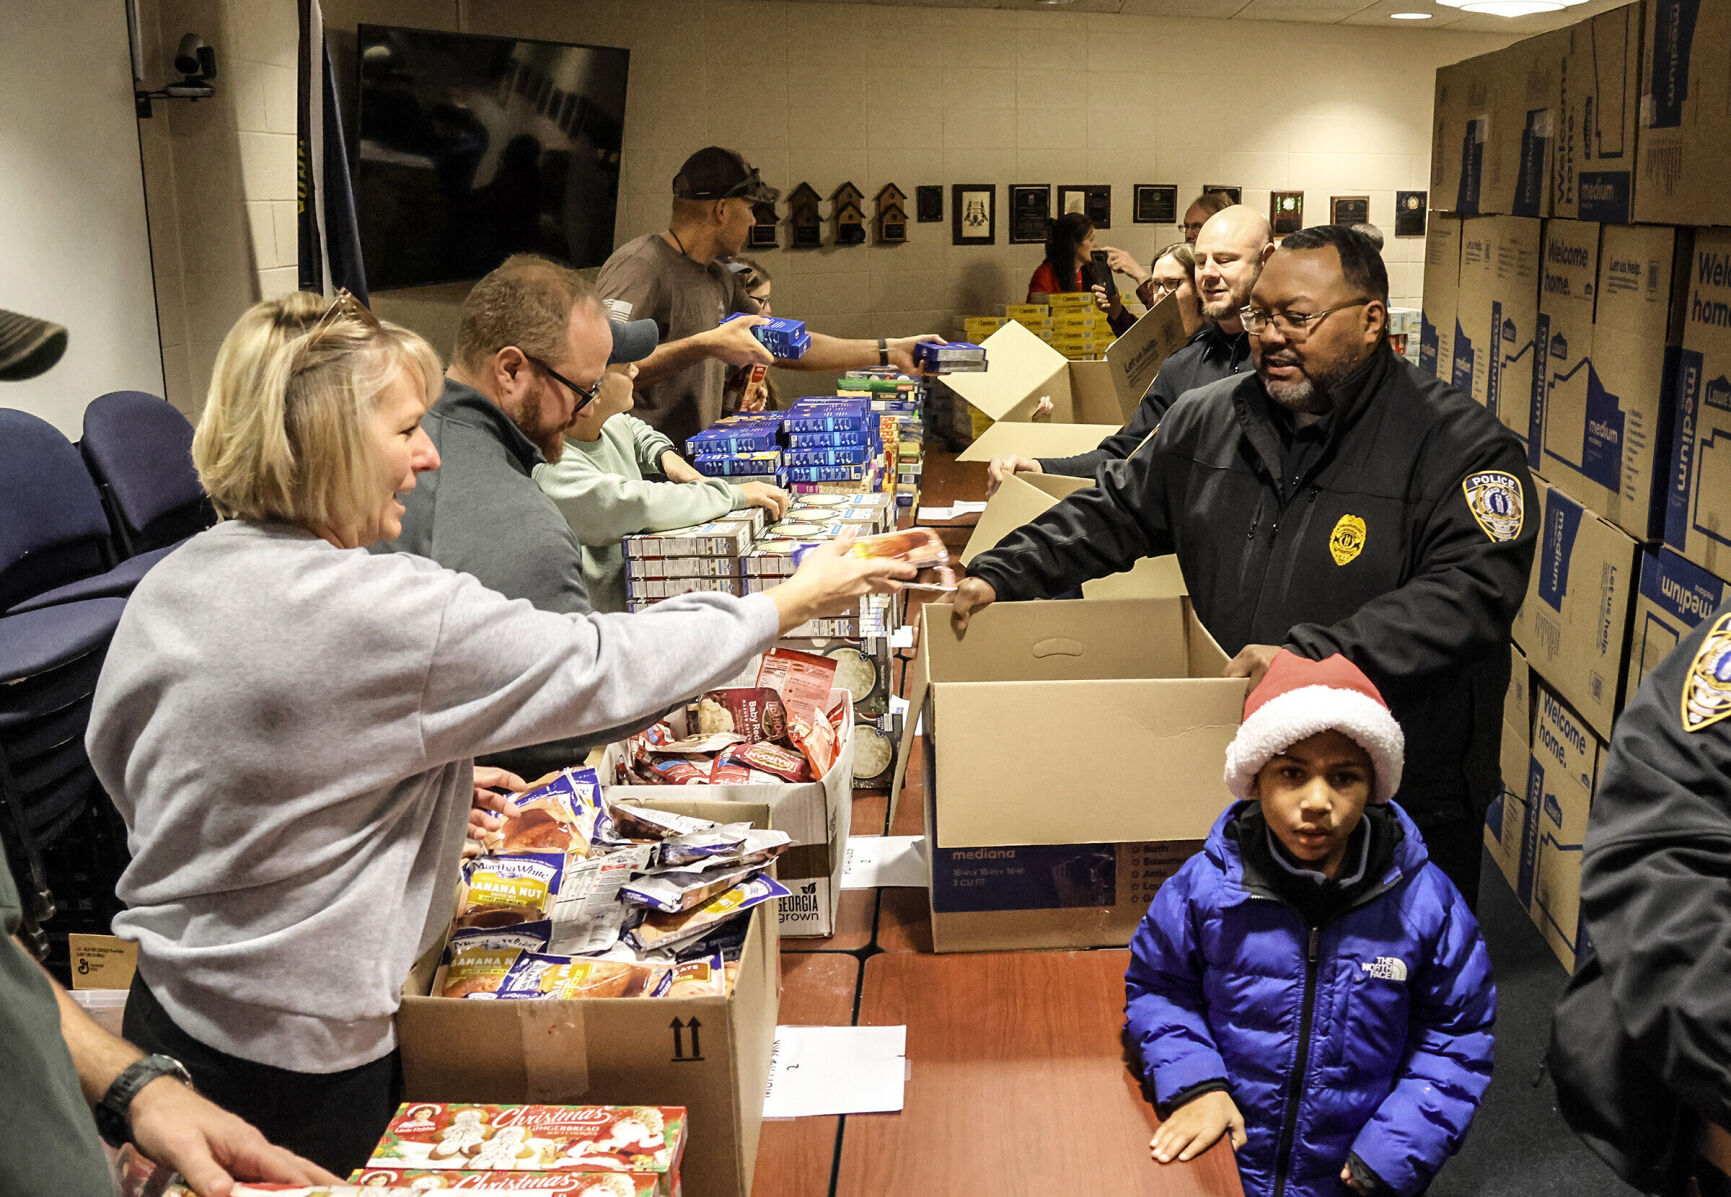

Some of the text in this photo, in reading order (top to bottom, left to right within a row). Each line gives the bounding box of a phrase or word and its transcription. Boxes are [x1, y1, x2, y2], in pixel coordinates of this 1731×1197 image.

[1549, 238, 1588, 268] Welcome
[1588, 420, 1618, 445] medium
[1677, 367, 1697, 492] medium
[1471, 474, 1515, 490] POLICE
[1552, 510, 1565, 592] medium
[1661, 575, 1713, 619] medium
[749, 701, 762, 741] Baby Red
[1544, 691, 1586, 755] Welcome
[1539, 716, 1567, 769] home.
[952, 848, 1016, 861] mediana
[472, 861, 516, 873] Martha
[517, 865, 550, 880] White
[519, 886, 543, 900] NUT
[779, 895, 819, 912] GEORGIA
[779, 913, 819, 923] grown
[1361, 963, 1393, 973] NORTH
[1376, 956, 1394, 964] THE
[1369, 971, 1393, 980] FACE
[492, 1105, 611, 1129] Christmas
[454, 1171, 579, 1192] Christmas
